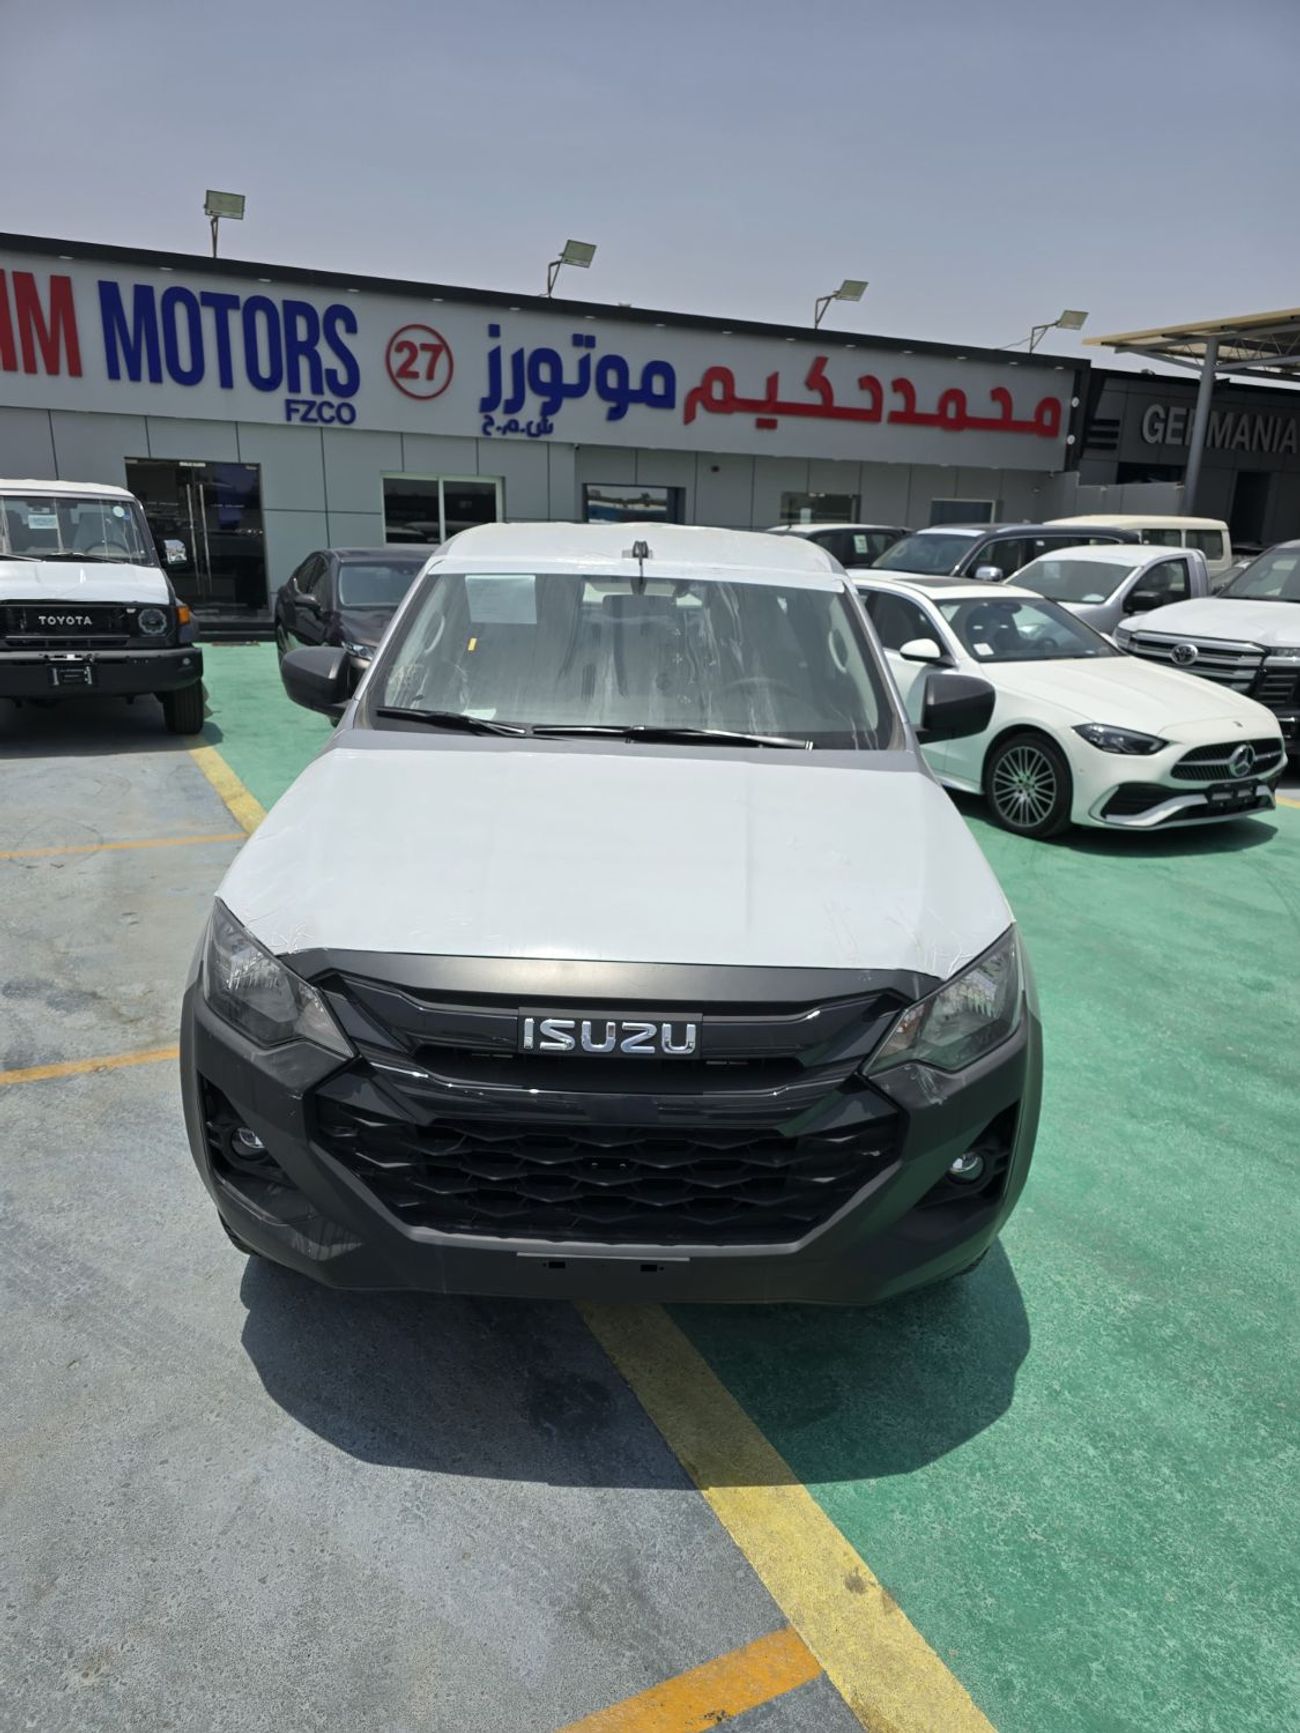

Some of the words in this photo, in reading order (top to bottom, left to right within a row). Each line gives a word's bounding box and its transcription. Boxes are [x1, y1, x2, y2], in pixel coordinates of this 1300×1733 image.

[97, 279, 361, 399] MOTORS
[394, 340, 444, 381] 27
[479, 323, 676, 422] موتورز
[284, 398, 357, 425] FZCO
[38, 615, 93, 626] TOYOTA
[523, 1017, 697, 1055] ISUZU
